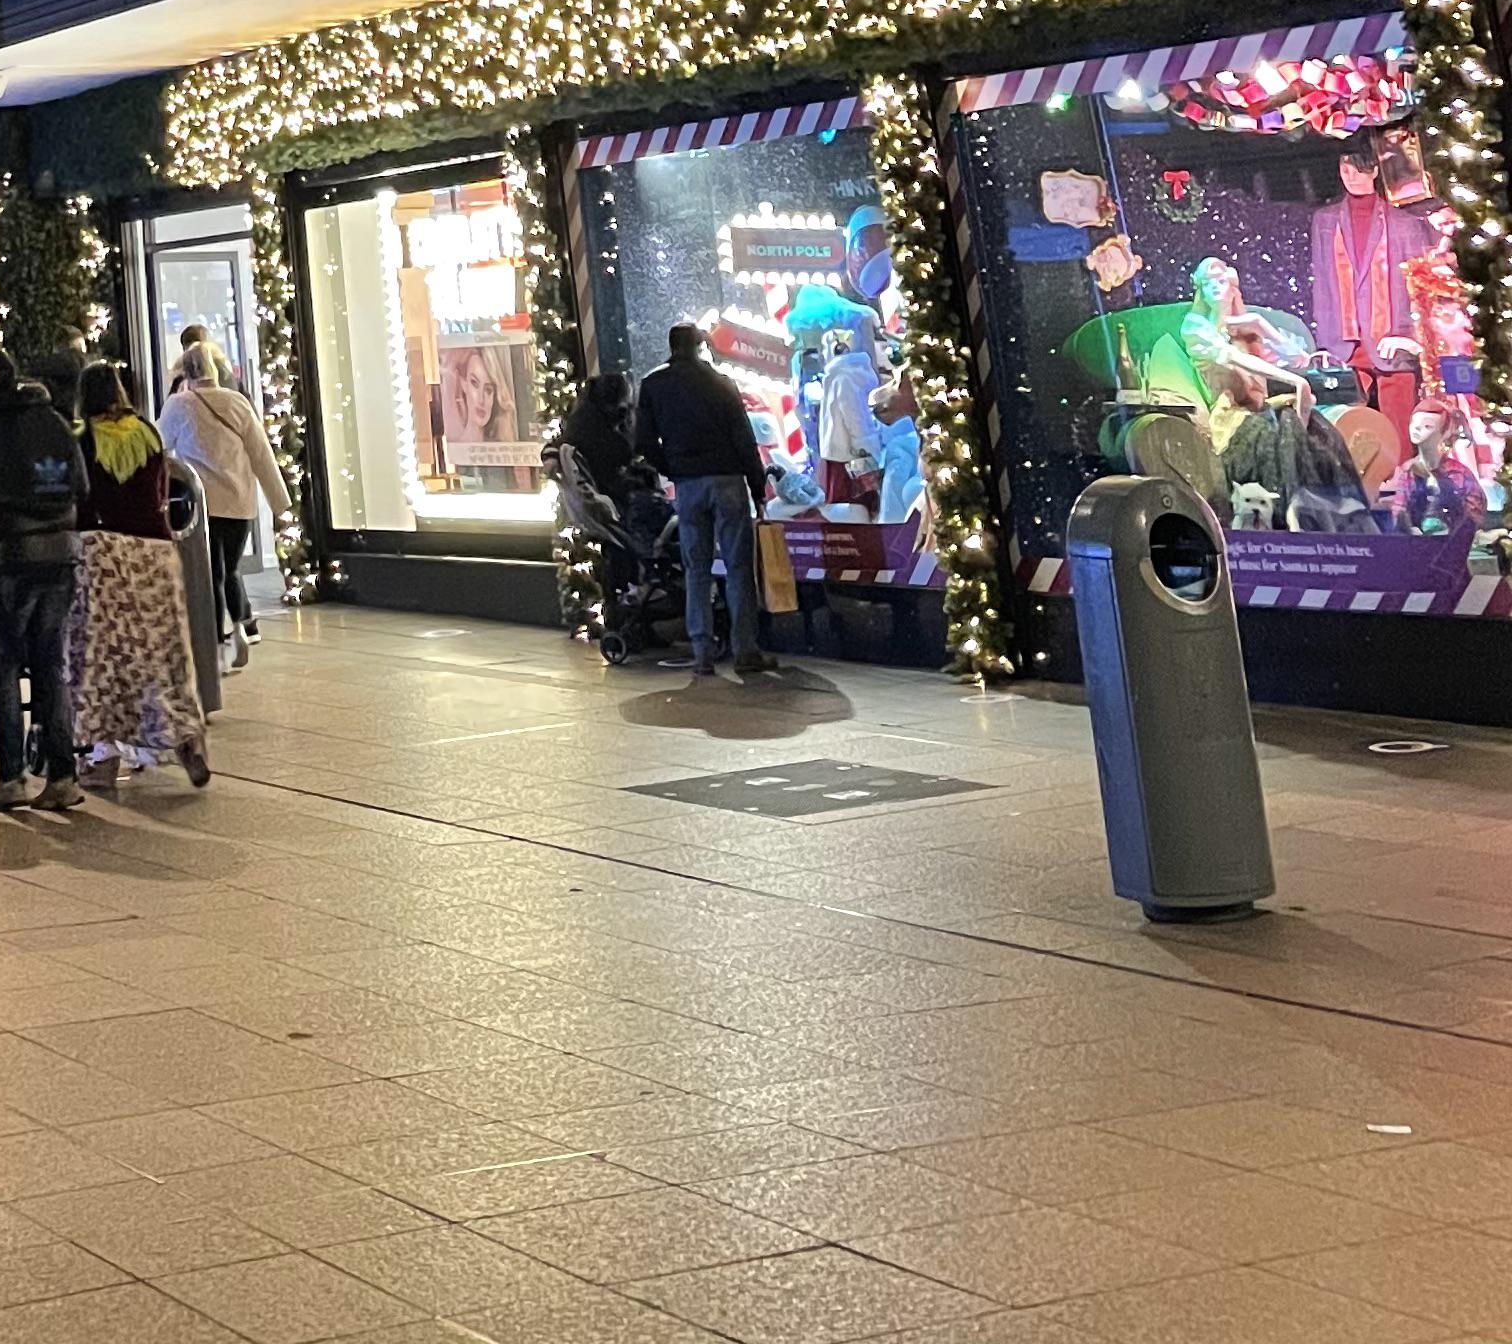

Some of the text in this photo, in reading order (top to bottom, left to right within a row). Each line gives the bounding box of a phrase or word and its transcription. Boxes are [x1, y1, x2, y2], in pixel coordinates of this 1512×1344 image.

[746, 244, 833, 258] NORTH POLE
[730, 338, 788, 367] ARNOTTS
